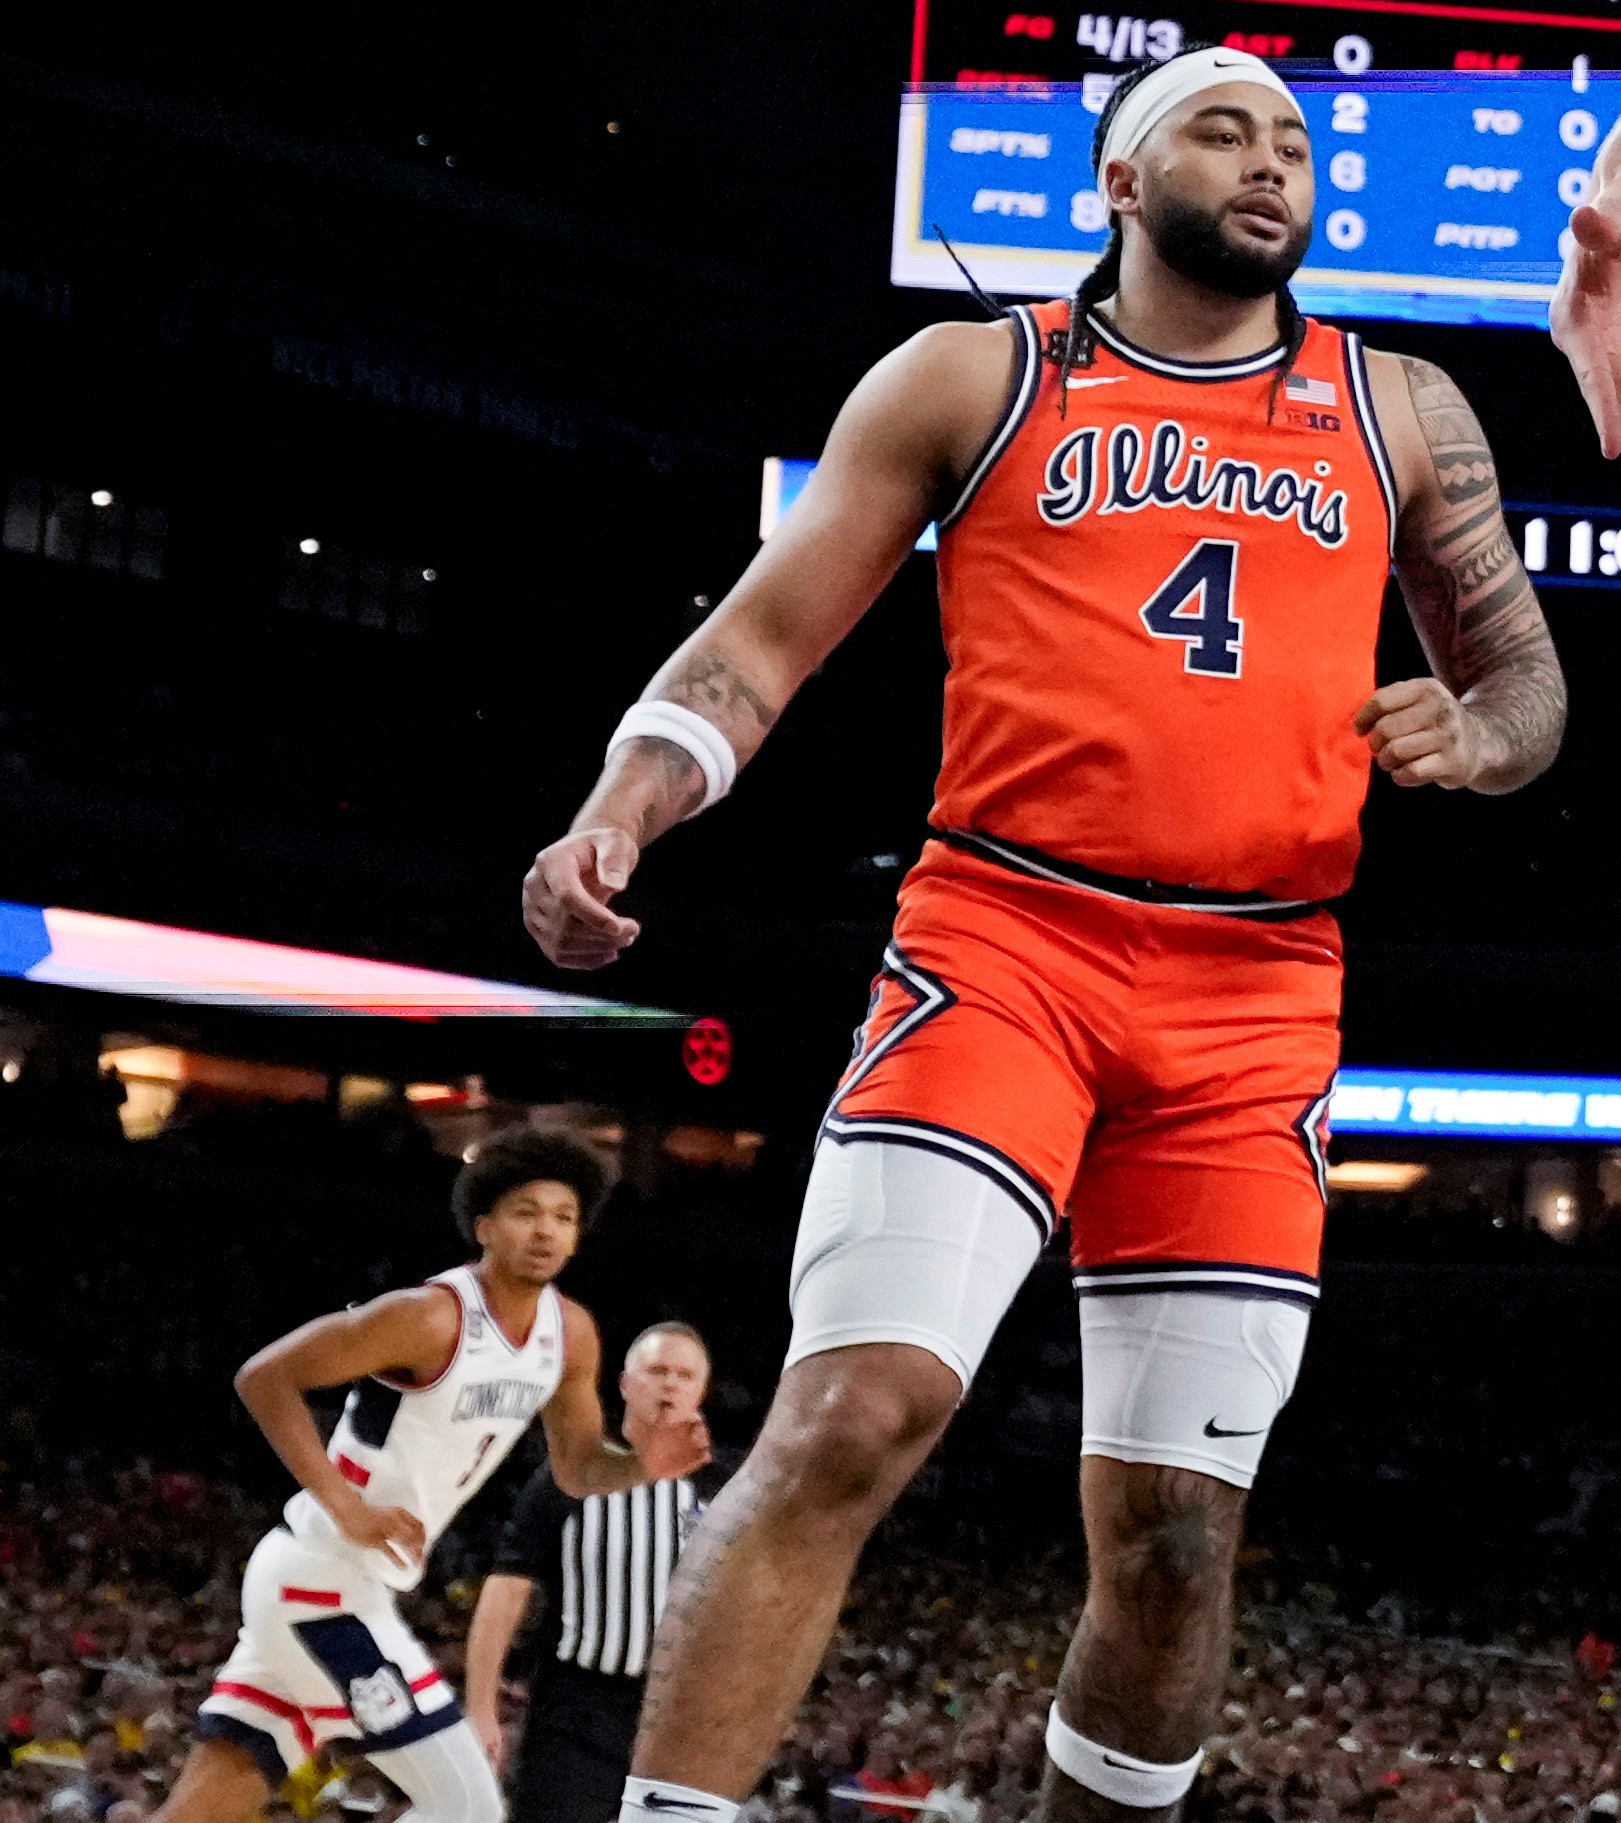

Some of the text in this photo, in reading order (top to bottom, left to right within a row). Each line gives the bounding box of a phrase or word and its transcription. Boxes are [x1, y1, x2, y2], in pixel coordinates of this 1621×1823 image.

[1077, 14, 1183, 63] 4/13
[1333, 34, 1373, 75] 0
[1331, 92, 1369, 134] 2
[1471, 108, 1523, 136] TO
[1559, 109, 1599, 152] 0
[1558, 167, 1594, 208] 0
[1325, 208, 1367, 251] 0
[1036, 419, 1350, 552] Illinois
[1138, 537, 1244, 680] 4
